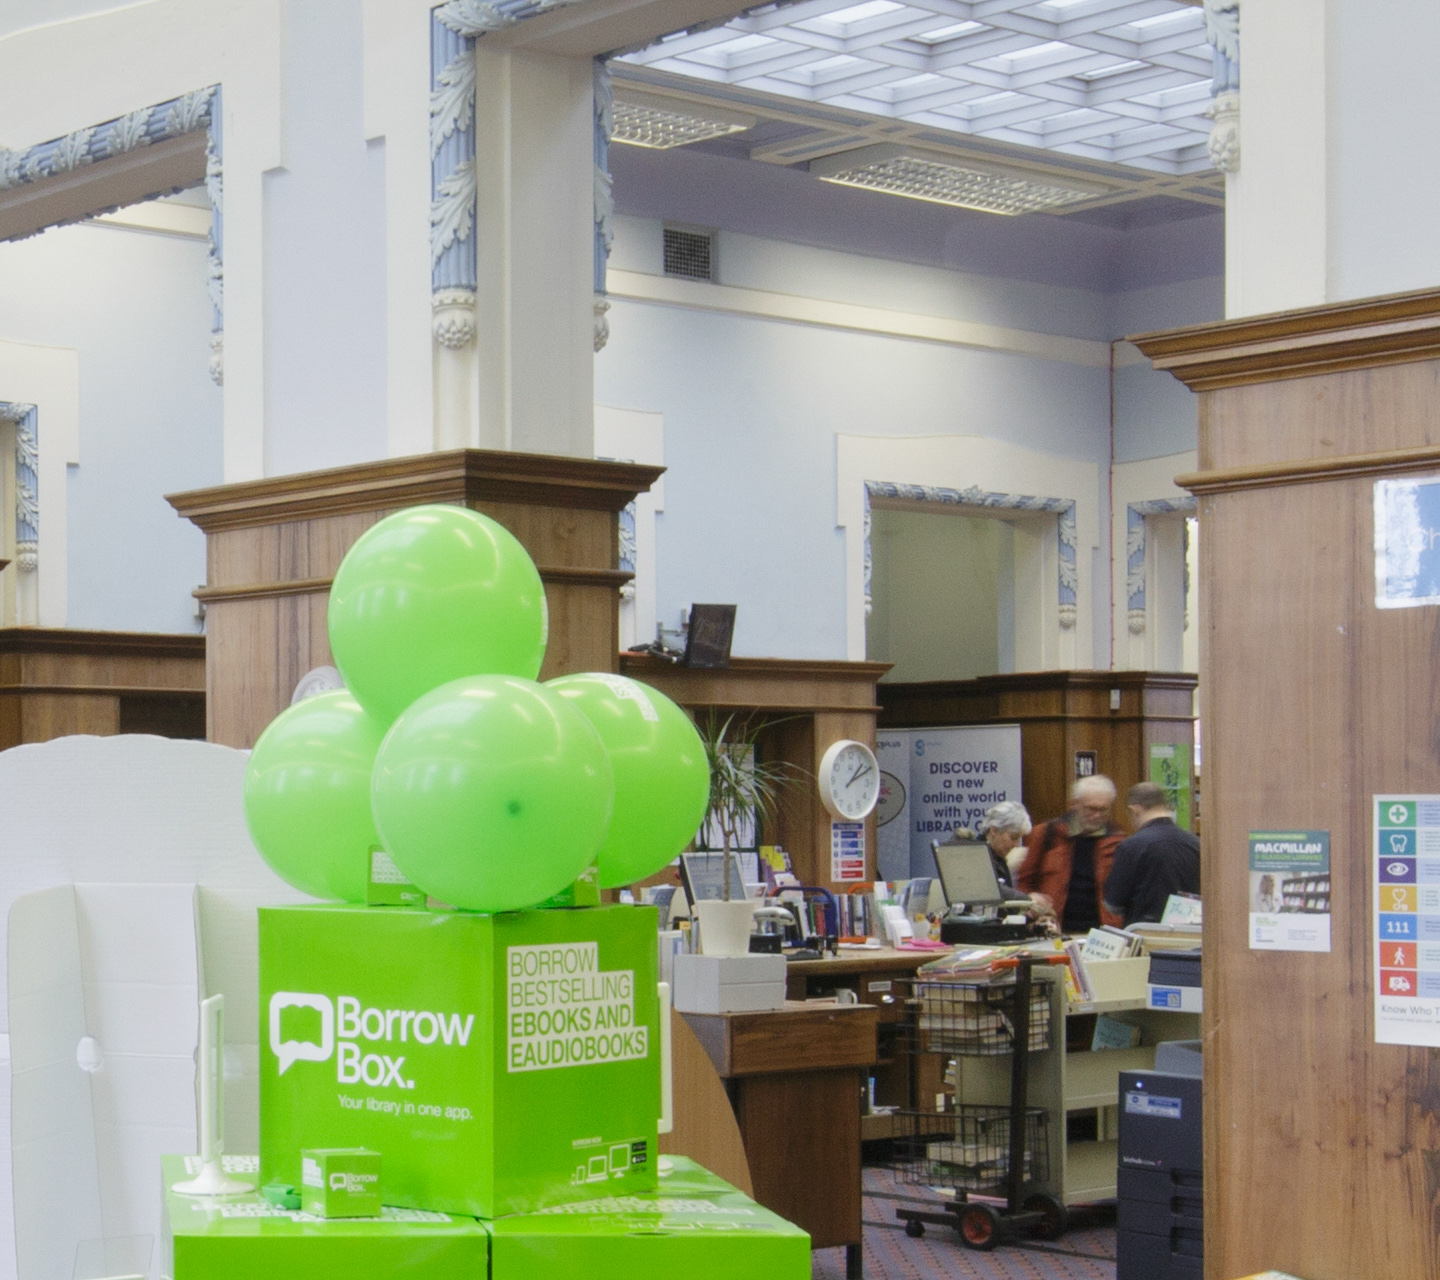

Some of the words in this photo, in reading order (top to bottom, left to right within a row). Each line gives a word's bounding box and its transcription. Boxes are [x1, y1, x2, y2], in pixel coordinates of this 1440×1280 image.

[929, 761, 998, 775] DISCOVER
[943, 778, 952, 788] a
[957, 778, 984, 788] new
[923, 792, 963, 805] online
[969, 791, 1006, 803] world
[933, 806, 961, 818] with
[1254, 843, 1323, 854] MACMILLAN
[1386, 921, 1410, 933] 111
[1090, 937, 1116, 952] ORHAN
[1086, 947, 1112, 960] PAMUK
[510, 948, 595, 977] BORROW
[510, 974, 631, 1007] BESTSELLING
[1381, 1004, 1407, 1015] Know
[1409, 1004, 1432, 1016] Who
[337, 995, 475, 1046] Borrow
[511, 1010, 591, 1038] EBOOKS
[595, 1004, 631, 1031] AND
[511, 1030, 646, 1068] EAUDIOBOOKS
[337, 1041, 415, 1089] Box.
[338, 1095, 363, 1111] Your
[366, 1096, 401, 1116] library
[404, 1099, 415, 1115] in
[418, 1104, 441, 1117] one
[445, 1105, 473, 1121] app.
[347, 1172, 378, 1184] Borrow
